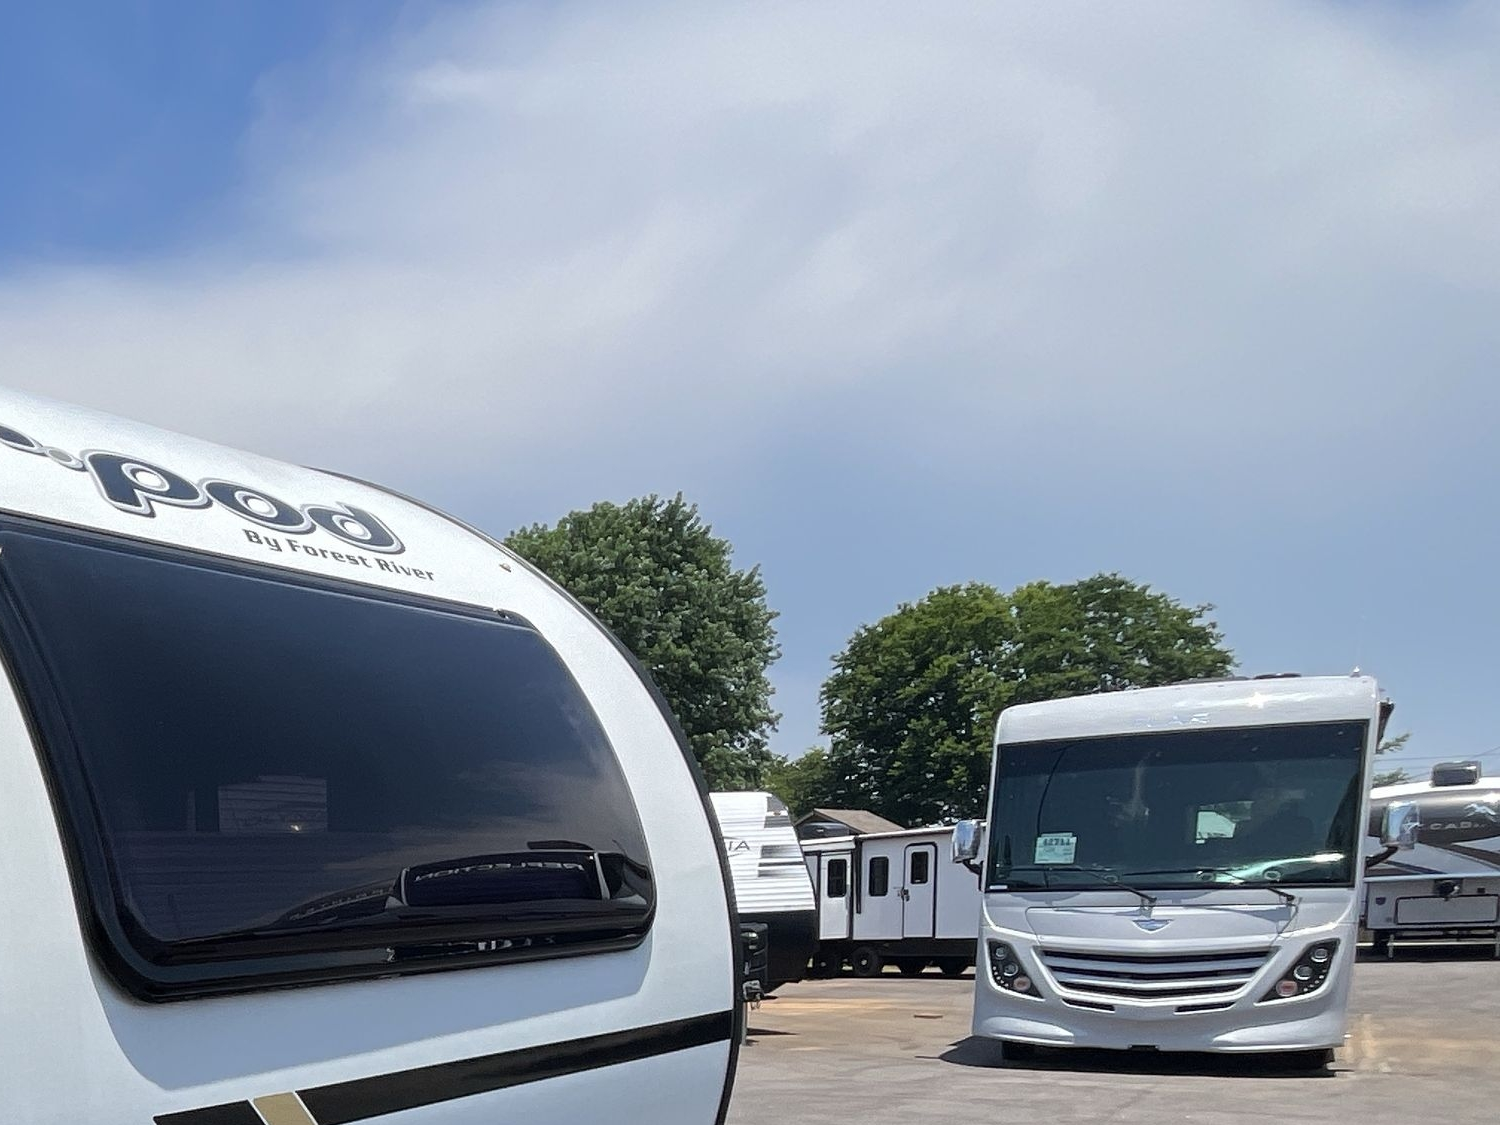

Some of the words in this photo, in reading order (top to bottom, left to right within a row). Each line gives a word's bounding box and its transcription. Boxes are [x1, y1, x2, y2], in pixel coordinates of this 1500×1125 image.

[243, 529, 283, 552] By
[286, 538, 372, 568] Forest
[375, 558, 435, 581] River
